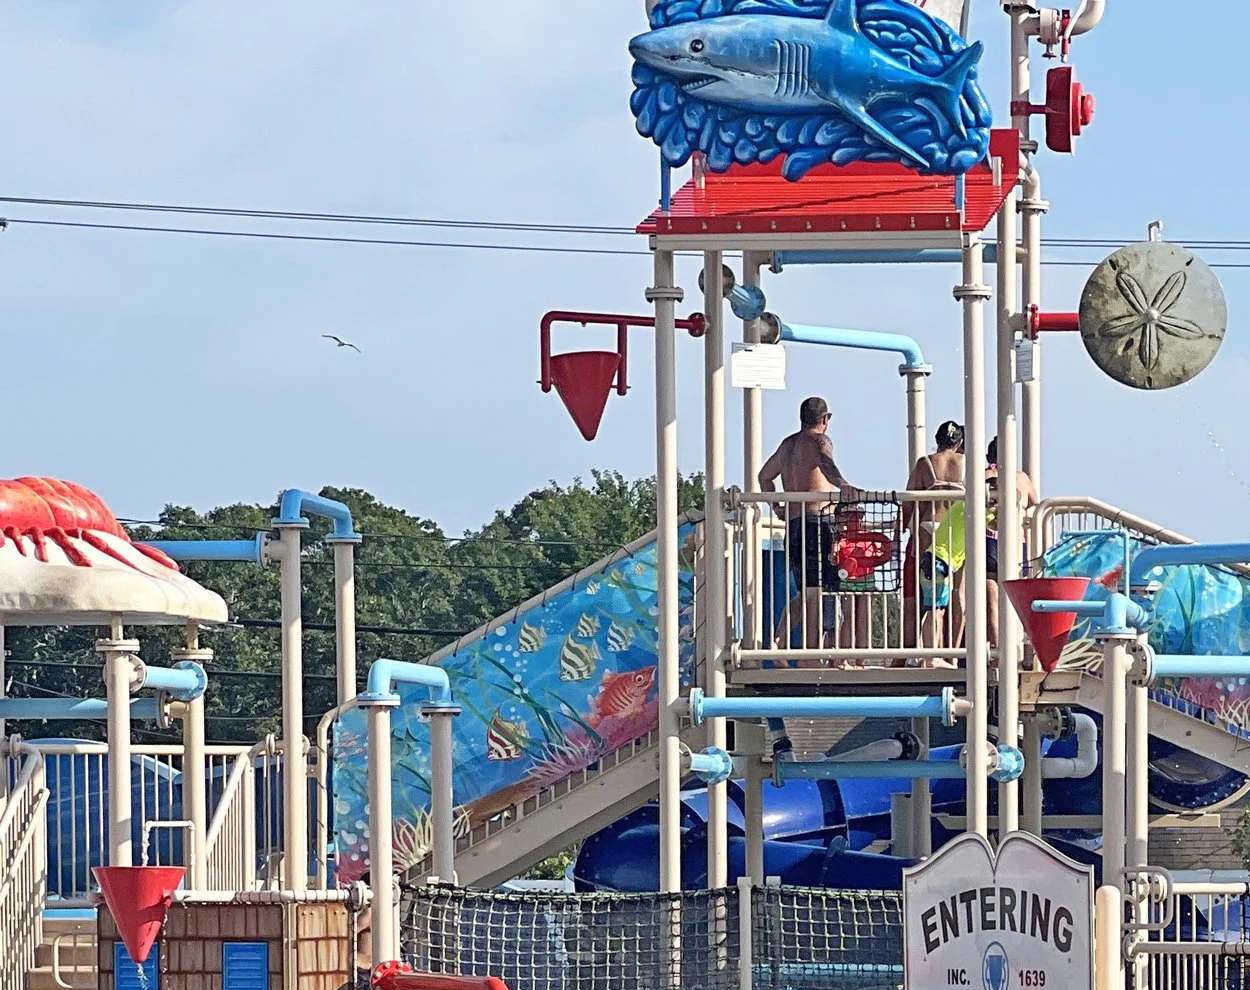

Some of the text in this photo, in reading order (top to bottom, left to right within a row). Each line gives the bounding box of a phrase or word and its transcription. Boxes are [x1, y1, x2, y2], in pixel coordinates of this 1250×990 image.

[920, 886, 1074, 955] ENTERING
[947, 968, 1046, 987] INC. 1639
